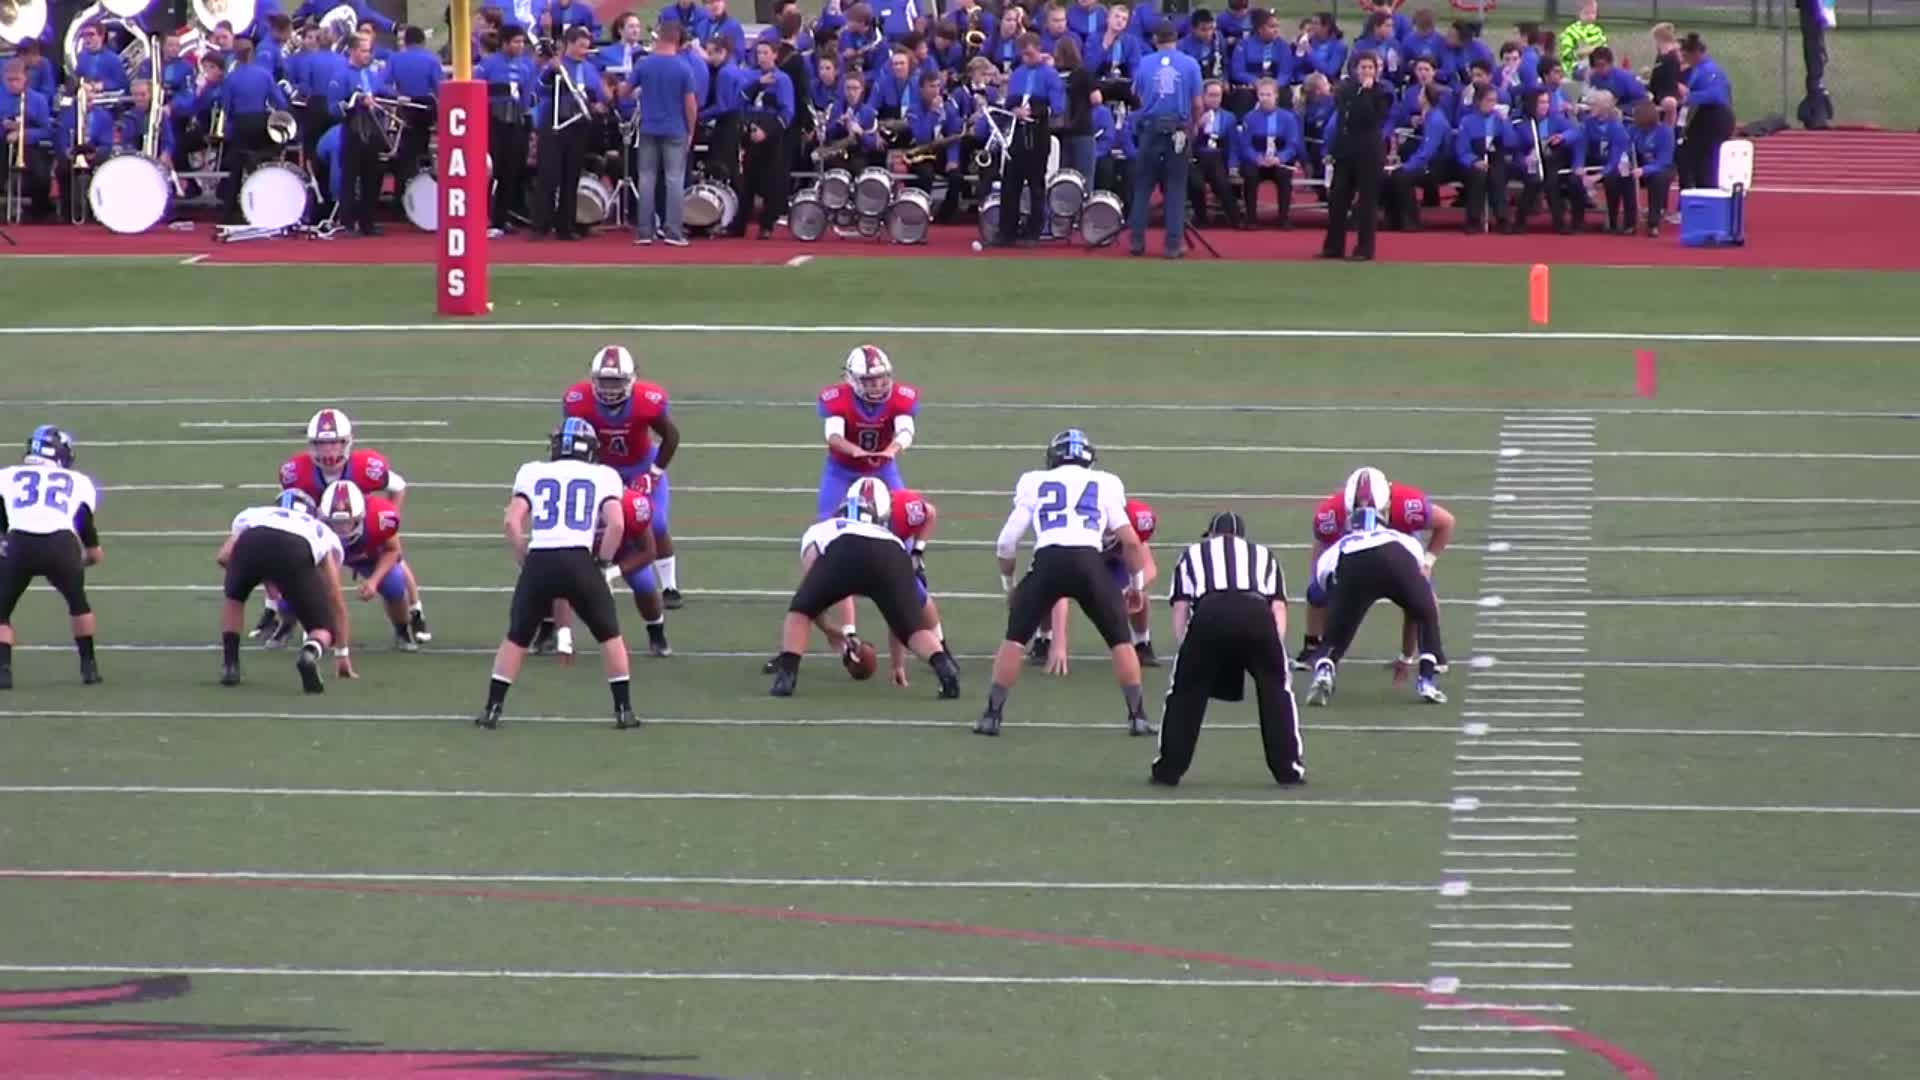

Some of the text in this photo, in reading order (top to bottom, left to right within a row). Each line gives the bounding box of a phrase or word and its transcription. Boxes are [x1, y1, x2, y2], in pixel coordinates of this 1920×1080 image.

[448, 107, 467, 297] CARDS
[607, 435, 629, 456] 4
[858, 430, 879, 453] 8
[13, 470, 74, 515] 32
[533, 477, 596, 531] 30
[1037, 480, 1101, 532] 24
